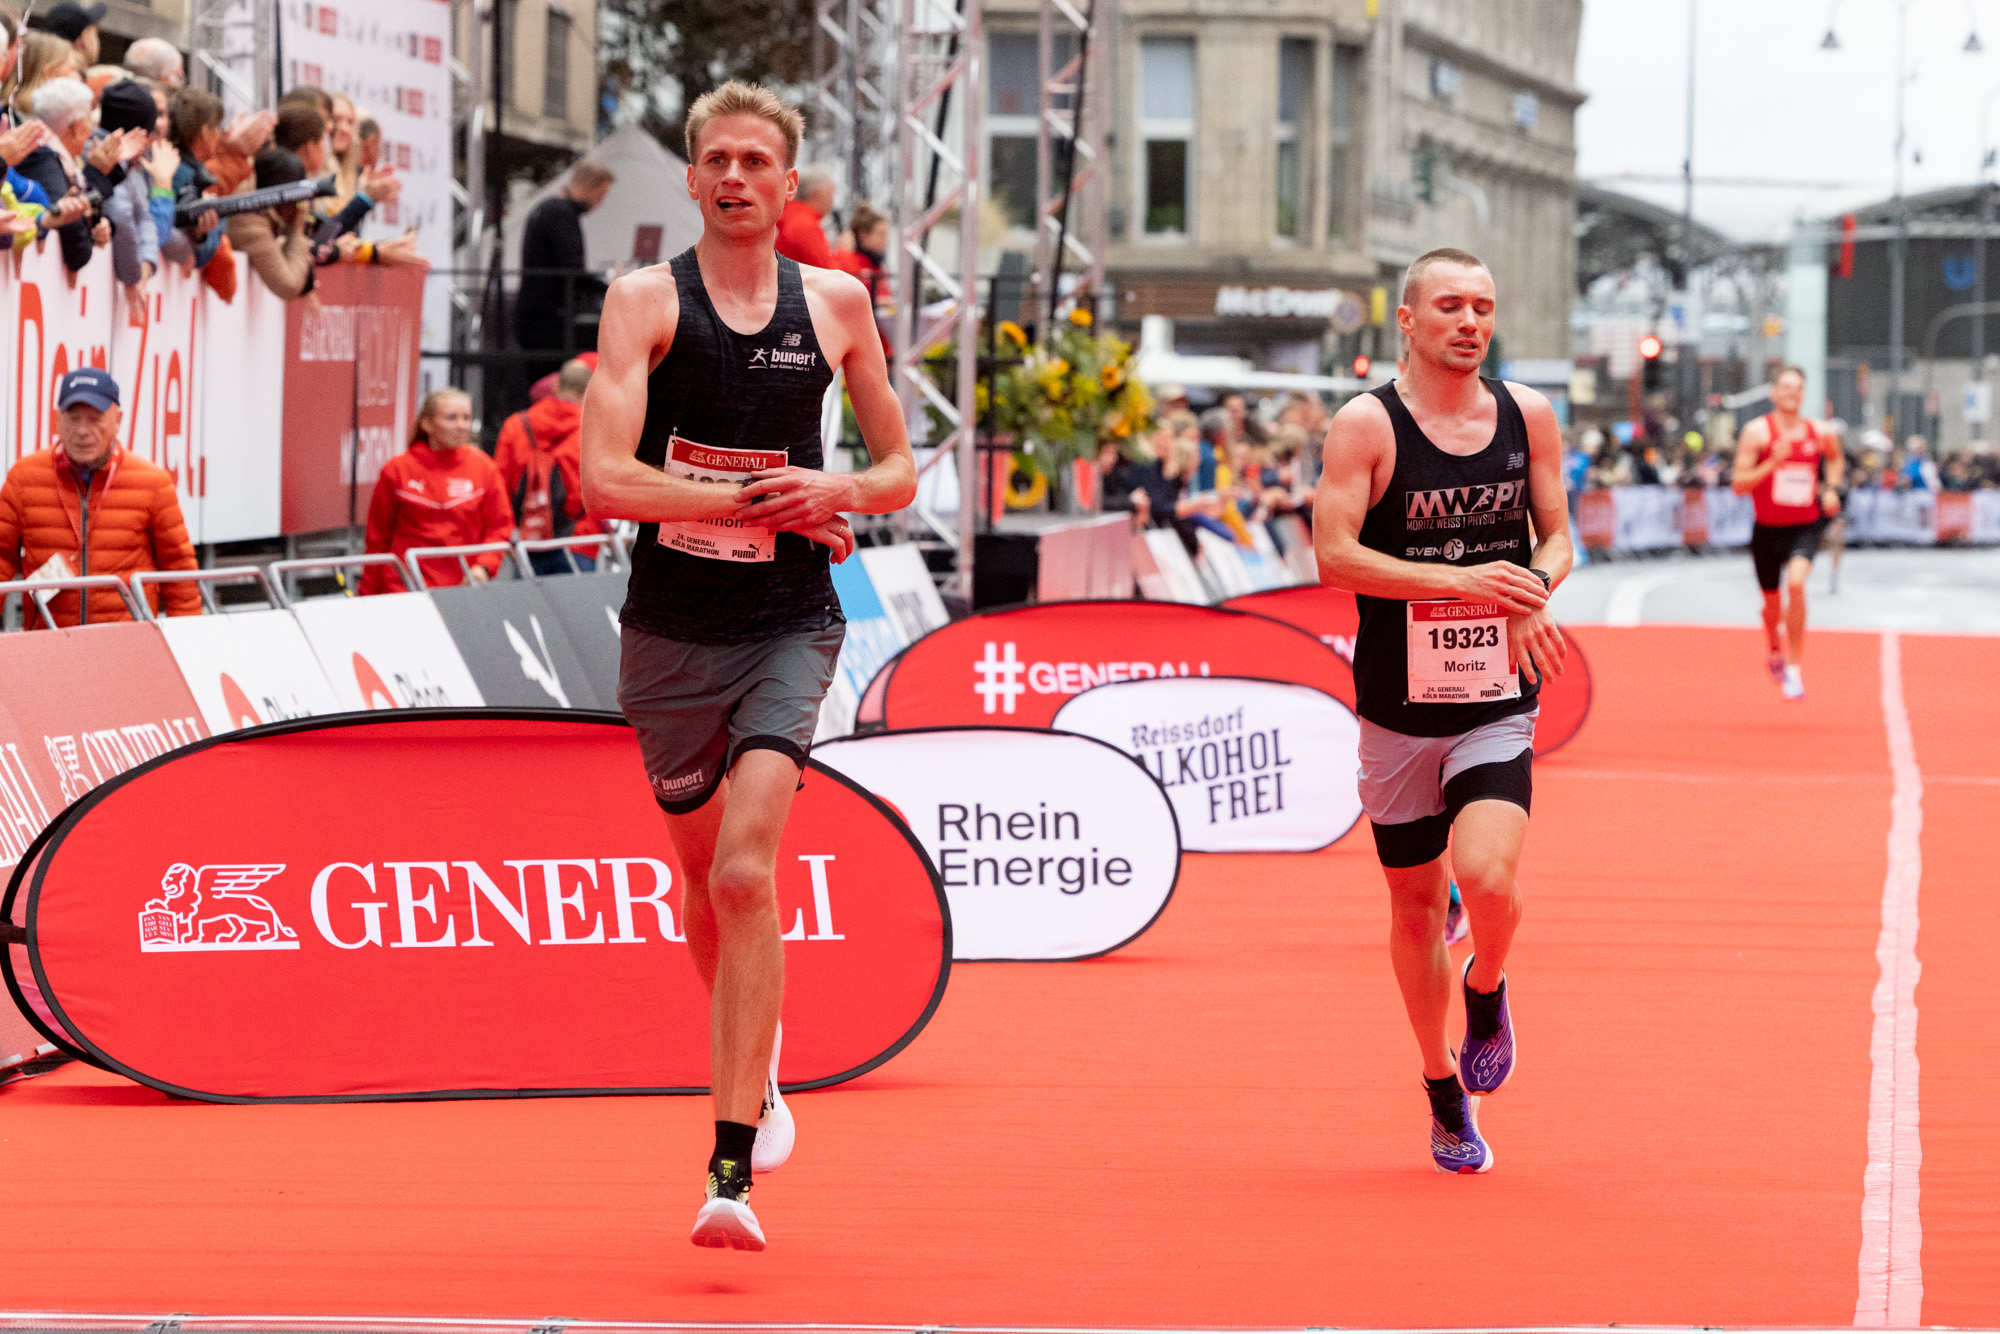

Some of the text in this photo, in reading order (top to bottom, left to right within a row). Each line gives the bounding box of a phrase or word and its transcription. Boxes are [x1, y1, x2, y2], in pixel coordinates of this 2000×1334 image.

[771, 348, 816, 367] bunert
[707, 453, 767, 469] GENERALI
[1406, 519, 1434, 531] MORITZ
[1436, 516, 1461, 529] WEISS
[1467, 513, 1496, 527] PHYSIO
[671, 538, 720, 556] KÖLN MARATHON
[677, 533, 716, 548] 24. GENERALI
[732, 549, 757, 559] PUMA
[1405, 546, 1442, 557] SVEN
[1447, 603, 1498, 617] GENERALI
[1428, 625, 1499, 650] 19323
[1444, 660, 1487, 673] Moritz
[1422, 691, 1438, 699] KÖLN
[1480, 689, 1502, 698] PUMA
[1131, 706, 1244, 748] Reissdorf
[1133, 728, 1291, 787] LKOHOL
[661, 768, 704, 791] bunert
[1208, 772, 1284, 824] FREI
[938, 802, 1080, 841] Rhein
[939, 847, 1133, 895] Energie
[309, 854, 846, 949] GENERI
